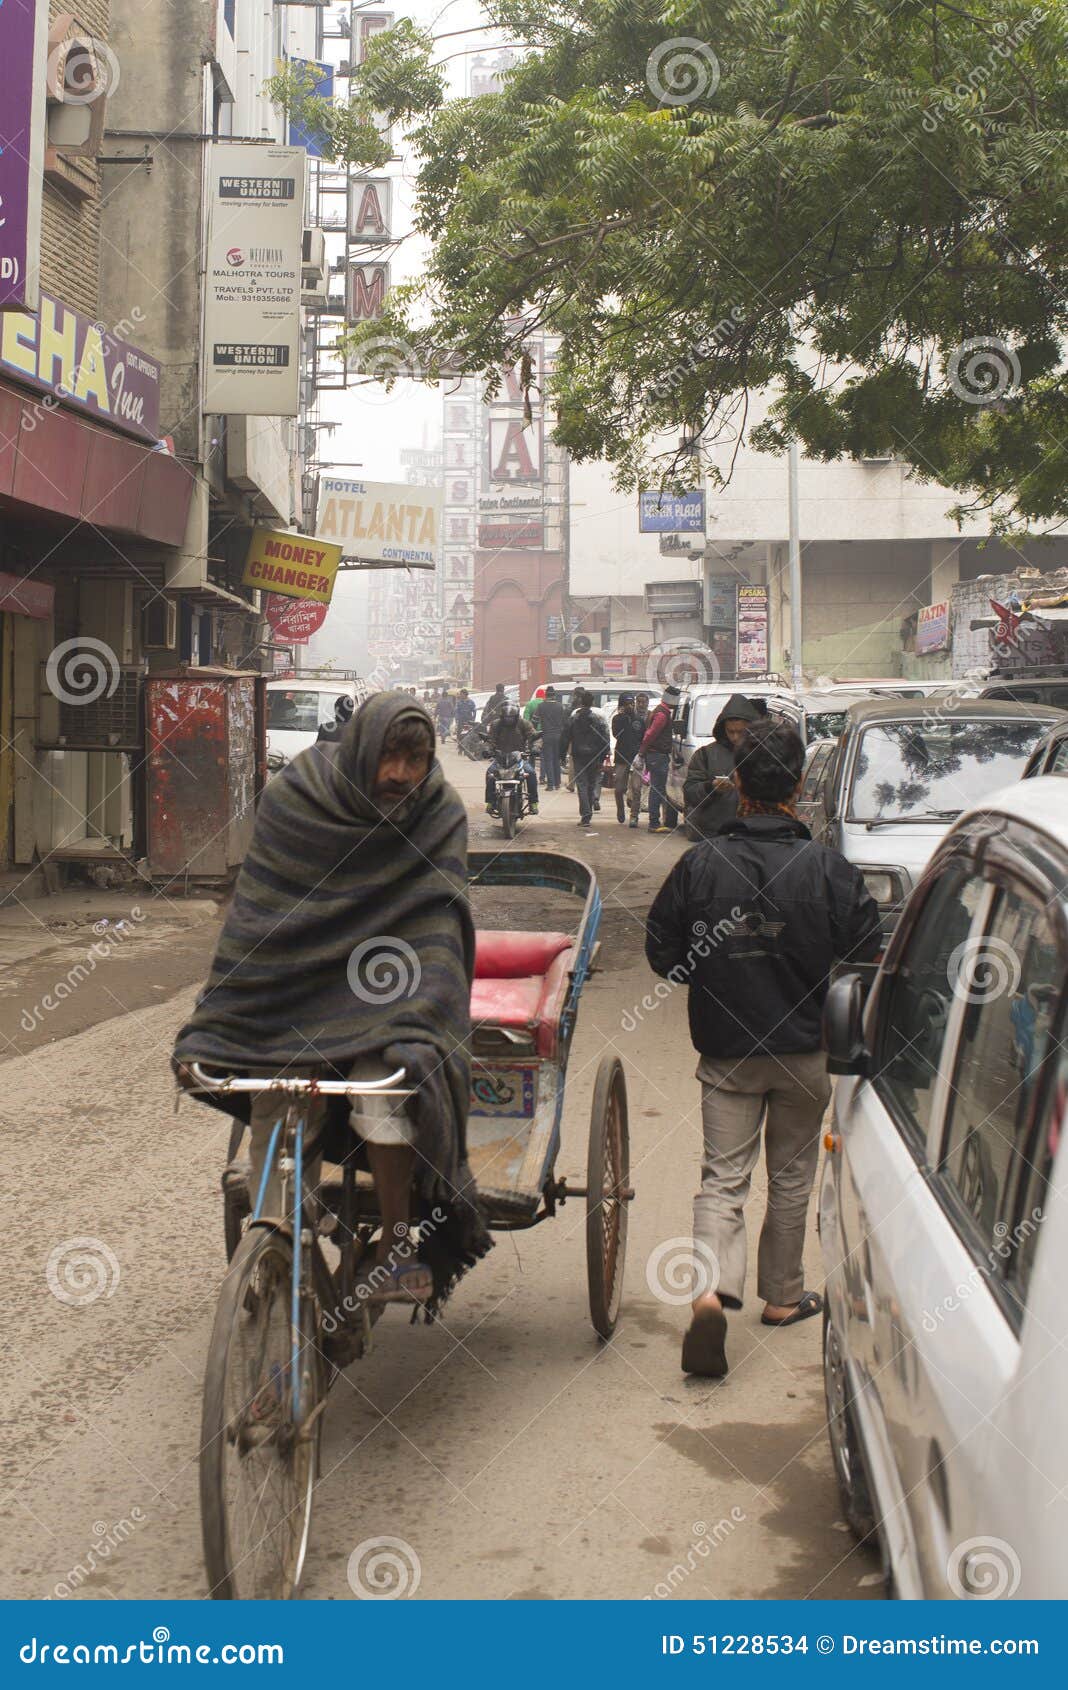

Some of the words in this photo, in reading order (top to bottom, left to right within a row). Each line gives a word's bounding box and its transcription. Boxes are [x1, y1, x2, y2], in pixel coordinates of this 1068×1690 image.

[222, 179, 280, 189] WESTERN
[240, 188, 280, 197] UNION
[213, 270, 262, 278] MALHOTRA
[265, 271, 295, 279] TOURS
[213, 286, 254, 294] TRAVELS
[256, 287, 275, 295] PVT.
[216, 346, 275, 355] WESTERN
[234, 355, 275, 364] UNION
[111, 362, 144, 424] Inn
[324, 480, 367, 494] HOTEL
[319, 498, 436, 545] ATLANTA
[264, 540, 326, 568] MONEY
[382, 547, 434, 561] CONTINENTAL
[250, 561, 330, 594] CHANGER
[919, 602, 947, 623] JATIN
